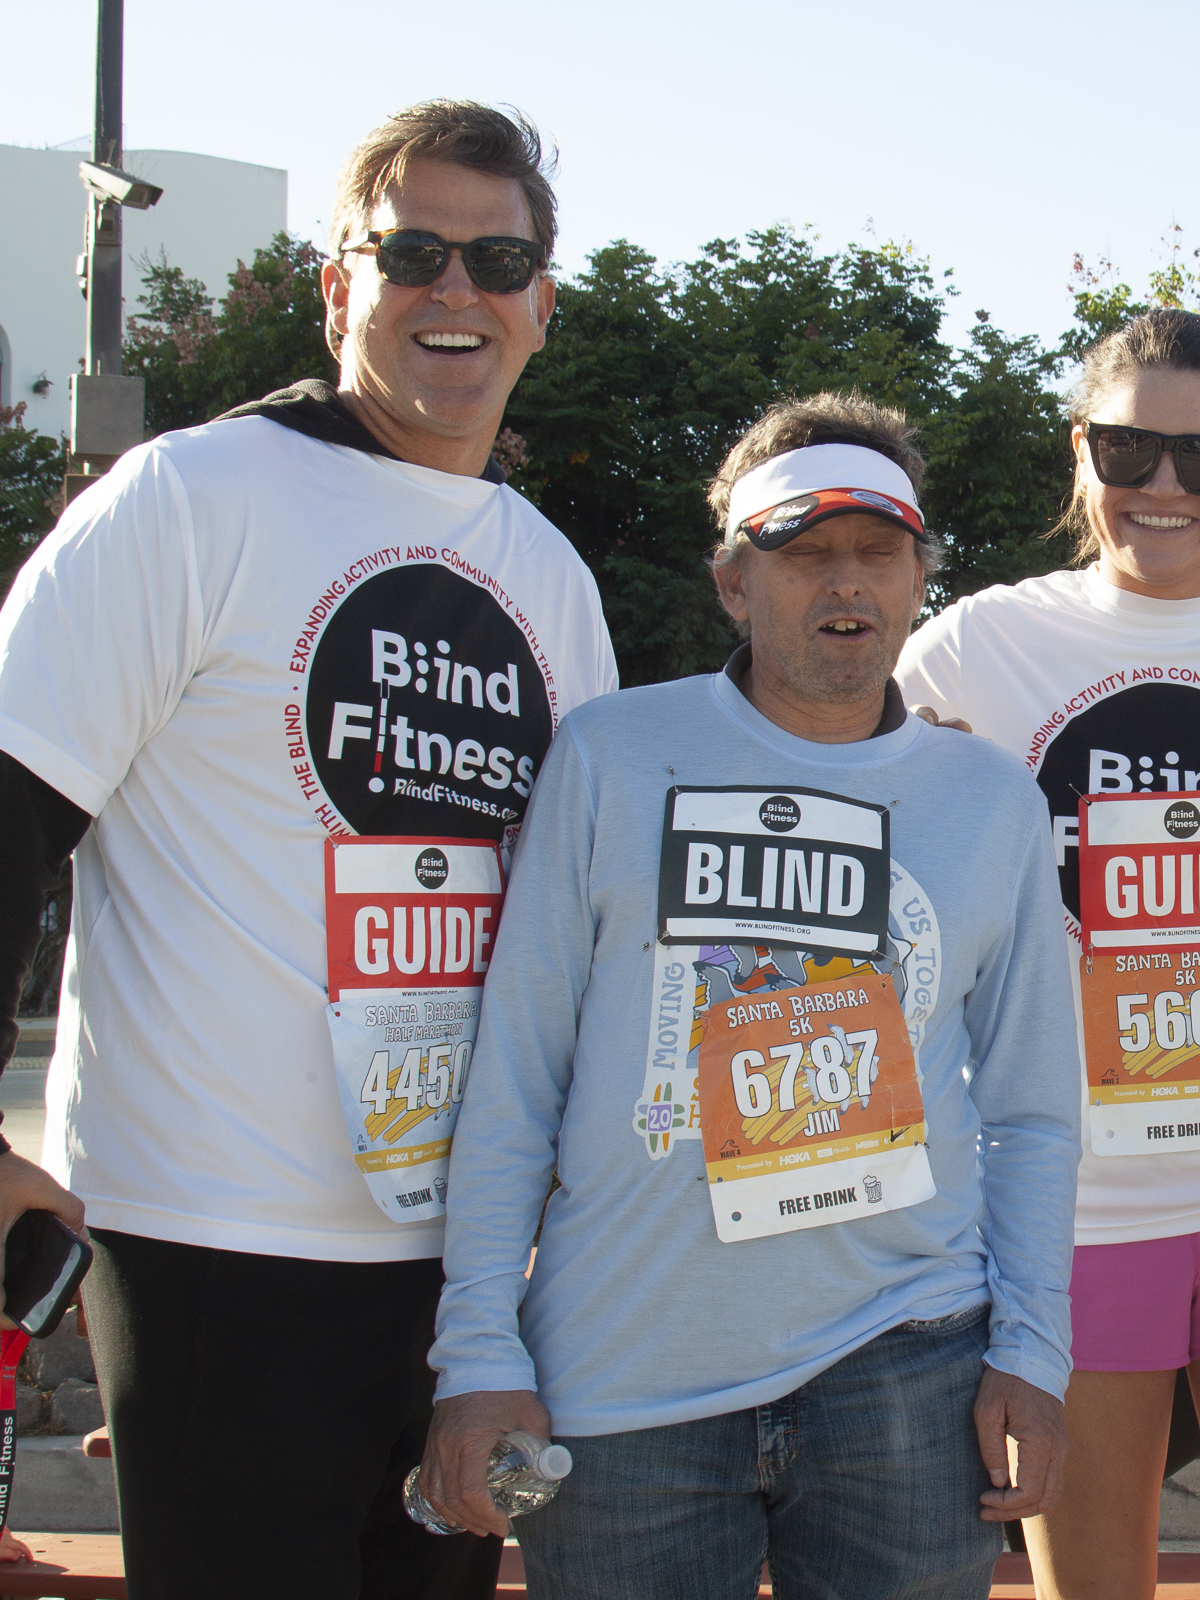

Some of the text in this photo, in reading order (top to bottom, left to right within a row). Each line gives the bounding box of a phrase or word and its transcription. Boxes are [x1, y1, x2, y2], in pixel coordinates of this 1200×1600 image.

[289, 580, 346, 674] EXPANDING
[343, 546, 401, 587] ACTIVITY
[406, 545, 437, 560] AND
[441, 548, 513, 608] COMMUNITY
[515, 607, 540, 651] WITH
[539, 652, 555, 687] THE
[1064, 670, 1127, 715] ACTIVITY
[1132, 667, 1163, 682] AND
[285, 704, 306, 759] BLIND
[293, 762, 320, 801] THE
[761, 812, 798, 824] Fitness
[1166, 819, 1199, 831] Fitness
[685, 842, 866, 916] BLIND
[902, 896, 933, 936] US
[354, 905, 492, 975] GUIDE
[734, 921, 812, 936] WWW.BLINDFITNESS.ORG
[1115, 951, 1173, 973] SANTA
[1174, 969, 1197, 986] 5K
[364, 1000, 478, 1027] SANTA BARBARA
[652, 961, 686, 1071] MOVING
[725, 988, 871, 1029] SANTA BARBARA
[384, 1022, 464, 1043] HALF MARATHON
[789, 1016, 814, 1036] 5K
[360, 1040, 474, 1116] 4450
[729, 1028, 879, 1118] 6787
[1151, 1086, 1179, 1097] HOKA
[649, 1109, 671, 1130] 20
[803, 1108, 841, 1137] JIM
[1147, 1124, 1175, 1140] FREE
[386, 1152, 409, 1164] HOKA
[720, 1150, 737, 1159] WAVE
[736, 1160, 764, 1171] Presented
[765, 1159, 772, 1167] by
[779, 1151, 811, 1166] HOKA
[395, 1187, 434, 1209] FREE DRINK
[778, 1187, 858, 1216] FREE DRINK
